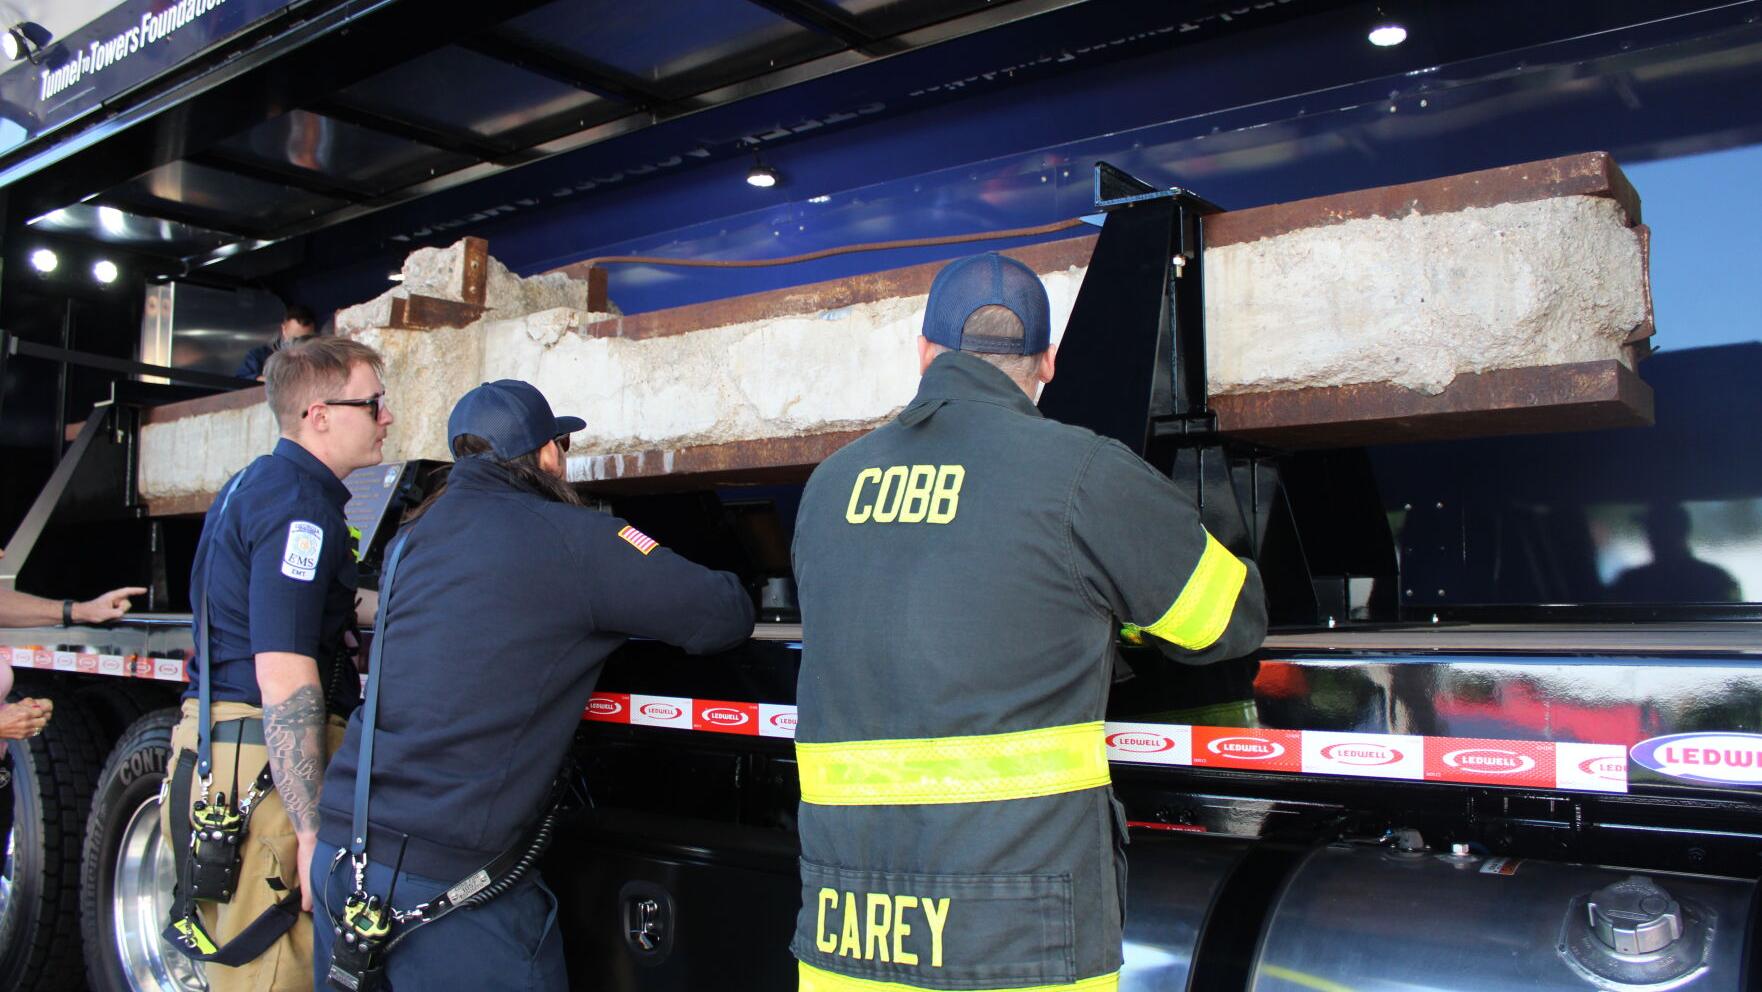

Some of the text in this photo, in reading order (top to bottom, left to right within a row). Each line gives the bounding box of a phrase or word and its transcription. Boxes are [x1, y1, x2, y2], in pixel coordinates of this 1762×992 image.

[41, 50, 83, 101] Tunnel
[90, 41, 140, 74] Towers
[140, 0, 227, 48] Foundat
[846, 464, 966, 524] COBB
[289, 553, 314, 568] EMS
[711, 712, 740, 721] LEDWELL
[1119, 738, 1161, 747] LEDWELL
[1223, 743, 1269, 753] LEDWELL
[1337, 750, 1387, 759] LEDWELL
[1461, 755, 1516, 766] LEDWELL
[120, 747, 166, 786] CONT
[816, 887, 951, 968] CAREY
